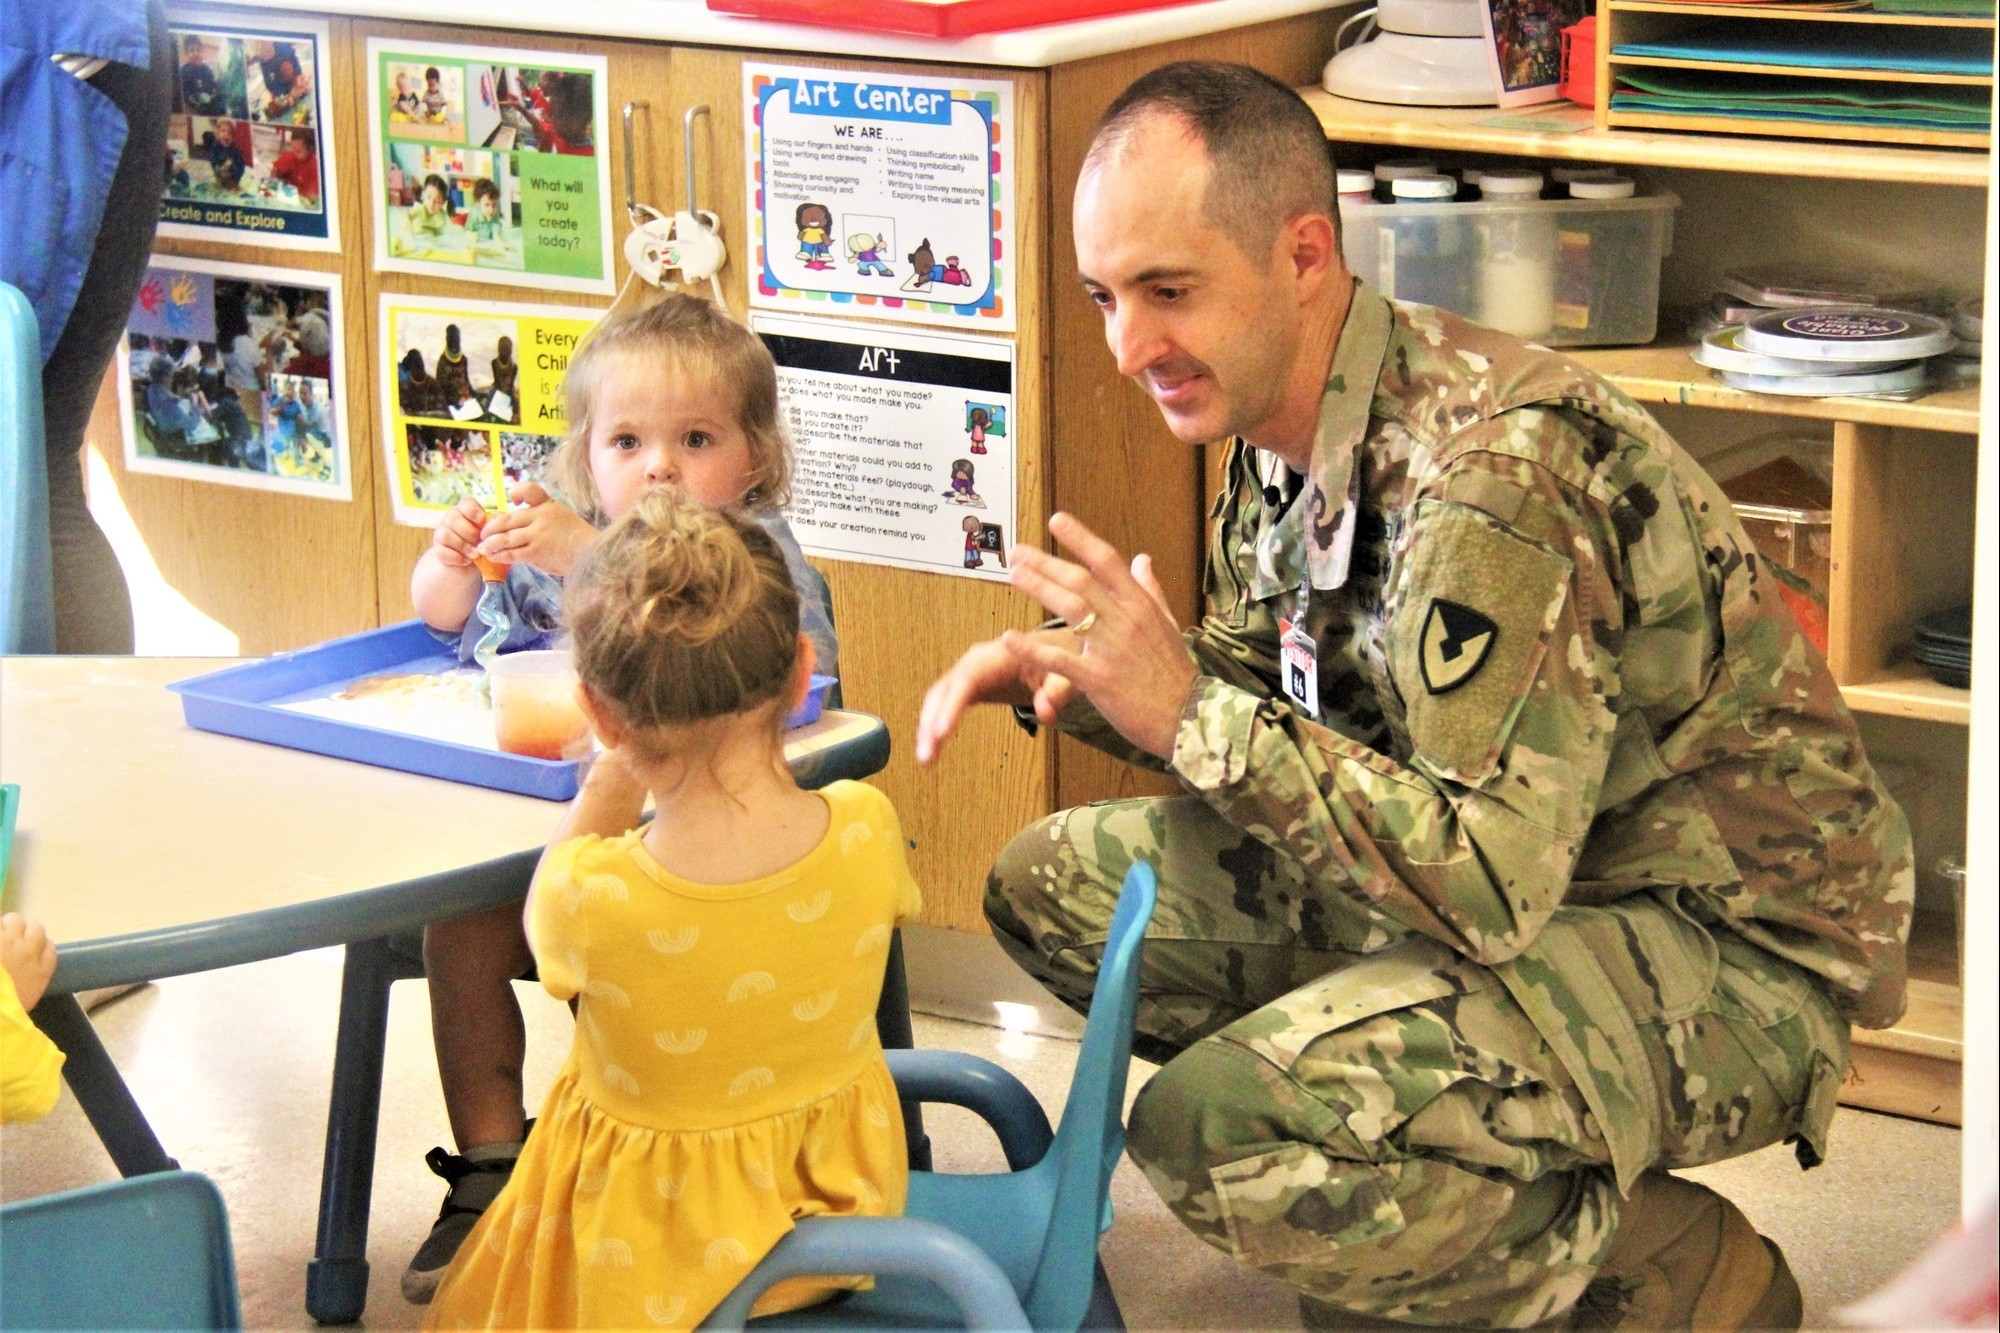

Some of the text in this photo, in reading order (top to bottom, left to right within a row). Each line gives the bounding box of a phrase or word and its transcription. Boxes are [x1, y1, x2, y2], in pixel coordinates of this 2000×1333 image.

[794, 79, 945, 116] Art Center
[834, 124, 855, 138] WE
[772, 137, 792, 148] Using
[807, 140, 833, 150] fingers
[835, 143, 849, 151] and
[851, 144, 873, 152] hands
[773, 148, 867, 164] Using writing and drawing
[886, 147, 979, 162] Using classification skills
[887, 157, 965, 174] Thinking symbolically
[773, 169, 859, 185] Attending and engaging
[887, 169, 935, 180] Writing name
[530, 178, 584, 194] What will
[773, 180, 854, 194] Showing curiosity and
[887, 180, 985, 197] Writing to convey meaning
[773, 191, 811, 201] motivation
[892, 190, 980, 205] Exploring the visual arts
[546, 200, 569, 212] you
[205, 209, 233, 224] and
[235, 210, 286, 230] Explore
[539, 218, 578, 231] create
[539, 234, 580, 251] today?
[1808, 326, 1865, 336] Giant
[536, 329, 579, 351] Every
[537, 354, 568, 371] Chil
[859, 346, 901, 375] Art
[540, 377, 550, 395] is
[787, 377, 801, 385] you
[833, 382, 858, 392] about
[861, 386, 882, 395] what
[886, 389, 902, 397] you
[904, 391, 932, 400] made?
[789, 387, 809, 396] does
[812, 390, 833, 398] what
[836, 393, 851, 401] you
[853, 395, 877, 404] made
[879, 398, 902, 407] make
[789, 407, 801, 415] did
[804, 409, 819, 417] you
[821, 411, 842, 419] make
[845, 413, 868, 423] that?
[790, 417, 801, 425] did
[804, 419, 819, 427] you
[820, 422, 849, 431] create
[804, 429, 841, 440] describe
[844, 433, 857, 442] the
[859, 436, 901, 447] materials
[904, 441, 923, 450] that
[820, 450, 860, 462] materials
[862, 456, 885, 466] could
[887, 460, 903, 468] you
[905, 461, 921, 470] add
[923, 463, 932, 471] to
[834, 461, 857, 472] Why?
[796, 478, 832, 489] eathers,
[803, 468, 817, 476] the
[819, 471, 859, 483] materials
[862, 475, 883, 485] feel?
[795, 497, 900, 517] can you make with these
[805, 489, 842, 500] describe
[845, 494, 866, 503] what
[869, 497, 885, 506] you
[887, 499, 901, 508] are
[903, 501, 938, 514] making?
[796, 517, 816, 526] does
[819, 520, 838, 529] your
[841, 523, 877, 534] creation
[878, 529, 908, 539] remind
[910, 533, 926, 541] you
